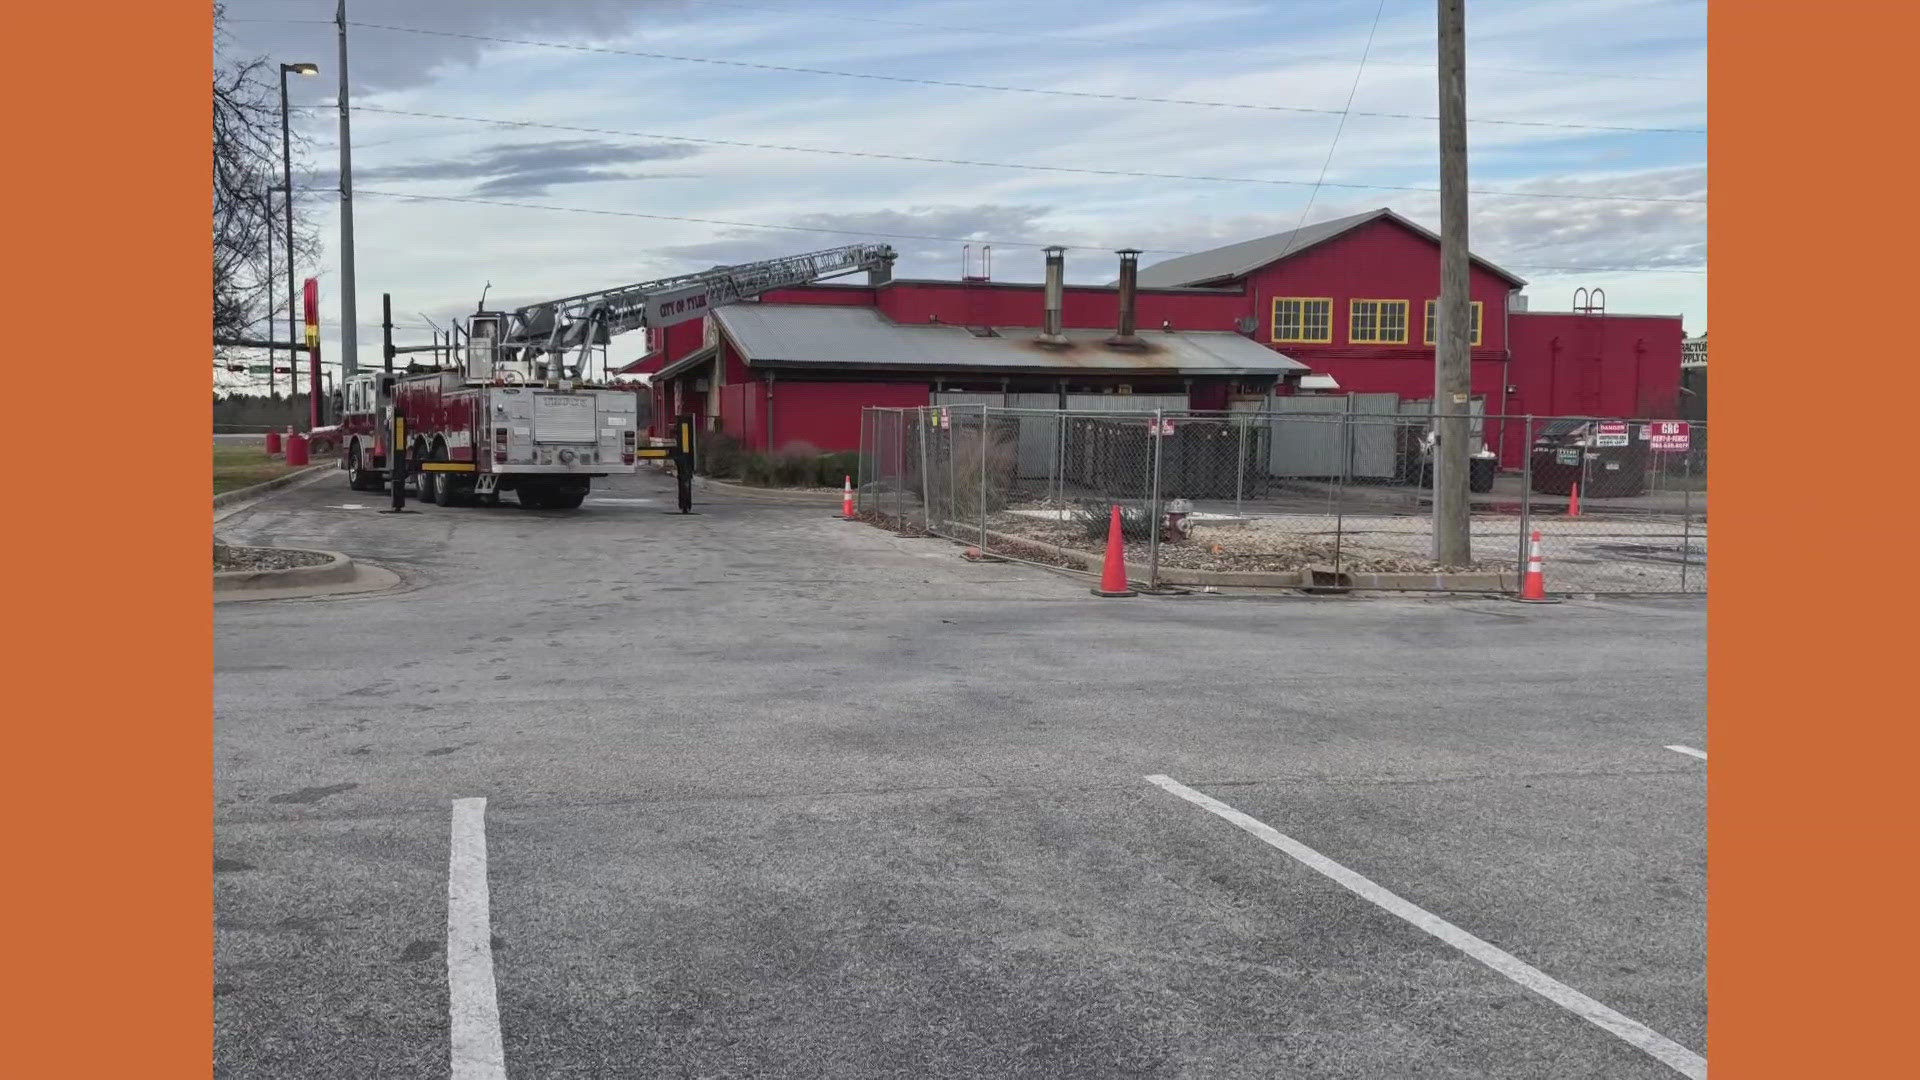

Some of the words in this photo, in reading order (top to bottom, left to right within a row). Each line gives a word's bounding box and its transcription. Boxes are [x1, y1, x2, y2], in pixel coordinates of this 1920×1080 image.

[660, 301, 675, 317] CITY
[676, 300, 685, 313] OF
[1661, 423, 1680, 434] CRC
